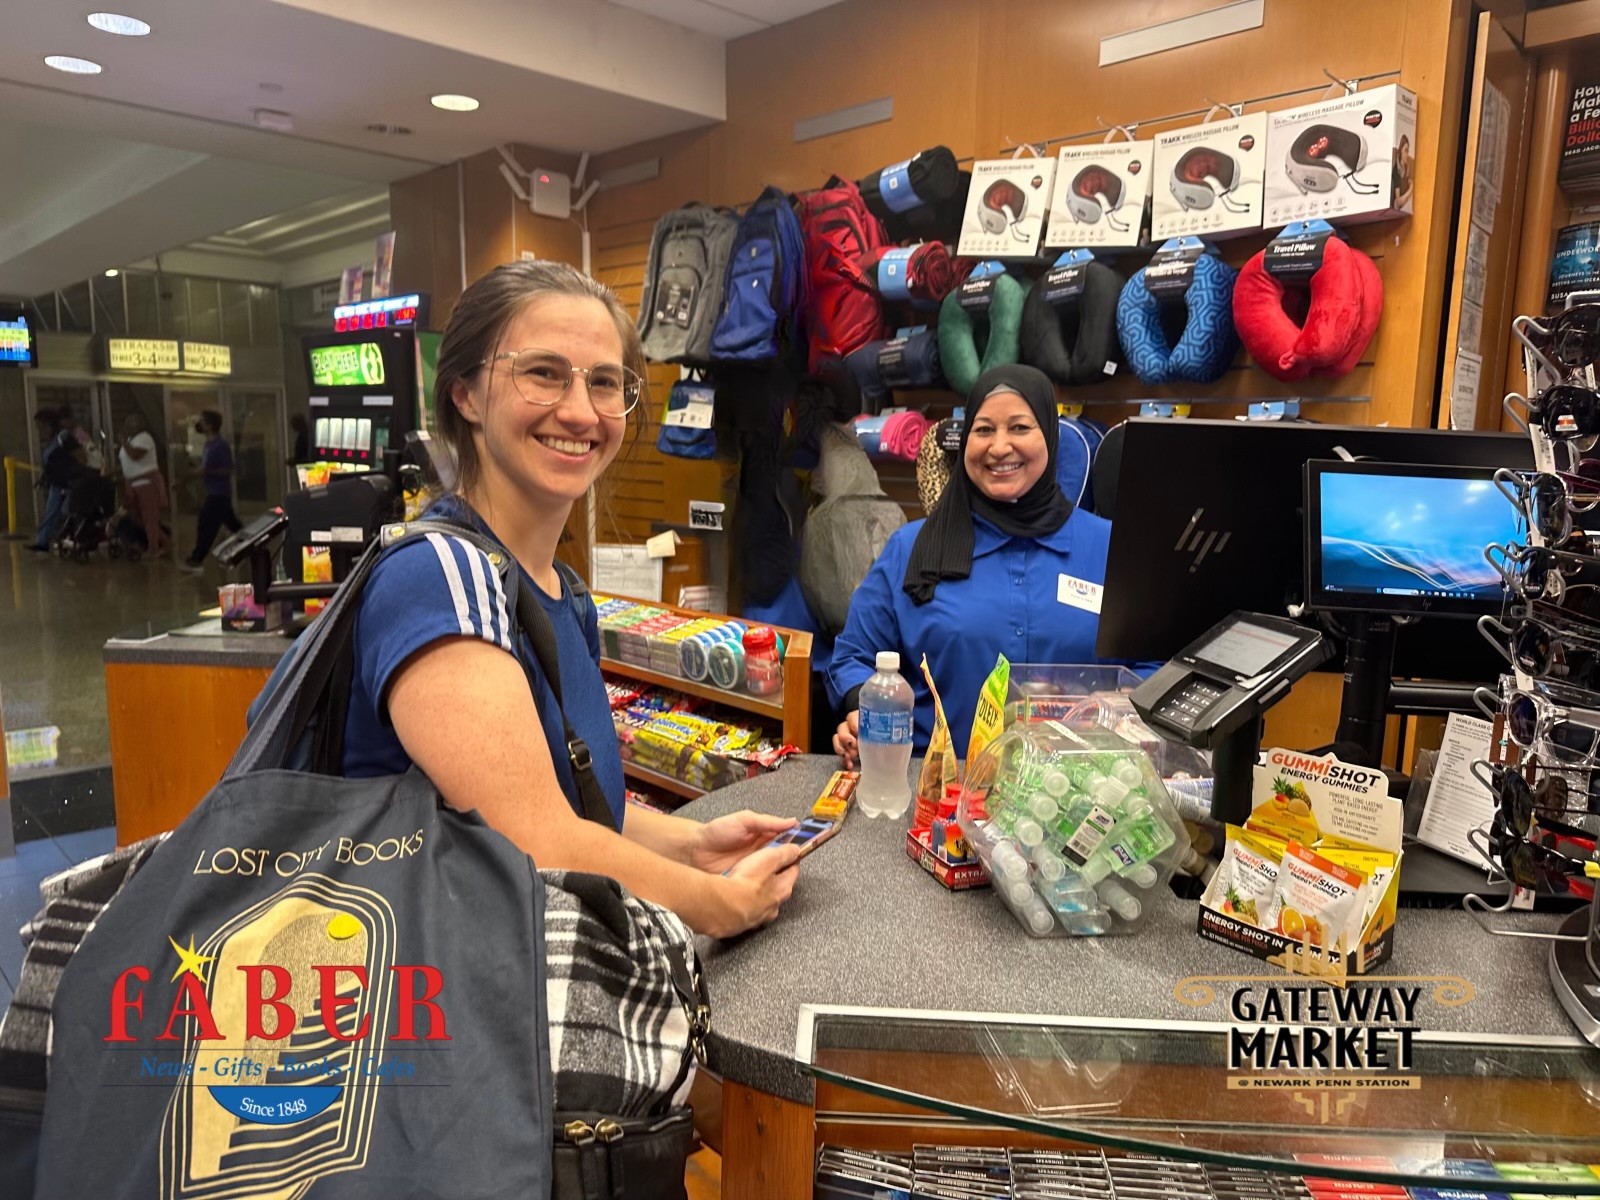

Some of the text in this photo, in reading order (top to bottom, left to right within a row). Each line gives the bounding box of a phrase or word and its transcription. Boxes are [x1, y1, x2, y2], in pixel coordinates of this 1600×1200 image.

[1297, 110, 1321, 119] WIRELESS
[1322, 104, 1344, 112] MASSAGE
[1345, 99, 1364, 108] PILLOW
[1570, 112, 1580, 123] a
[1222, 124, 1239, 132] PILLOW
[1273, 243, 1316, 254] Travel Pillow
[132, 351, 142, 367] 3
[149, 352, 157, 367] 4
[978, 693, 999, 730] OLELY
[1280, 767, 1369, 794] ENERGY GUMMIES
[193, 828, 424, 878] LOST CITY BOOKS
[1233, 848, 1278, 878] GUMMISHO
[1203, 910, 1242, 932] ENERGY
[1241, 927, 1271, 943] SHOT
[1271, 938, 1284, 949] IN
